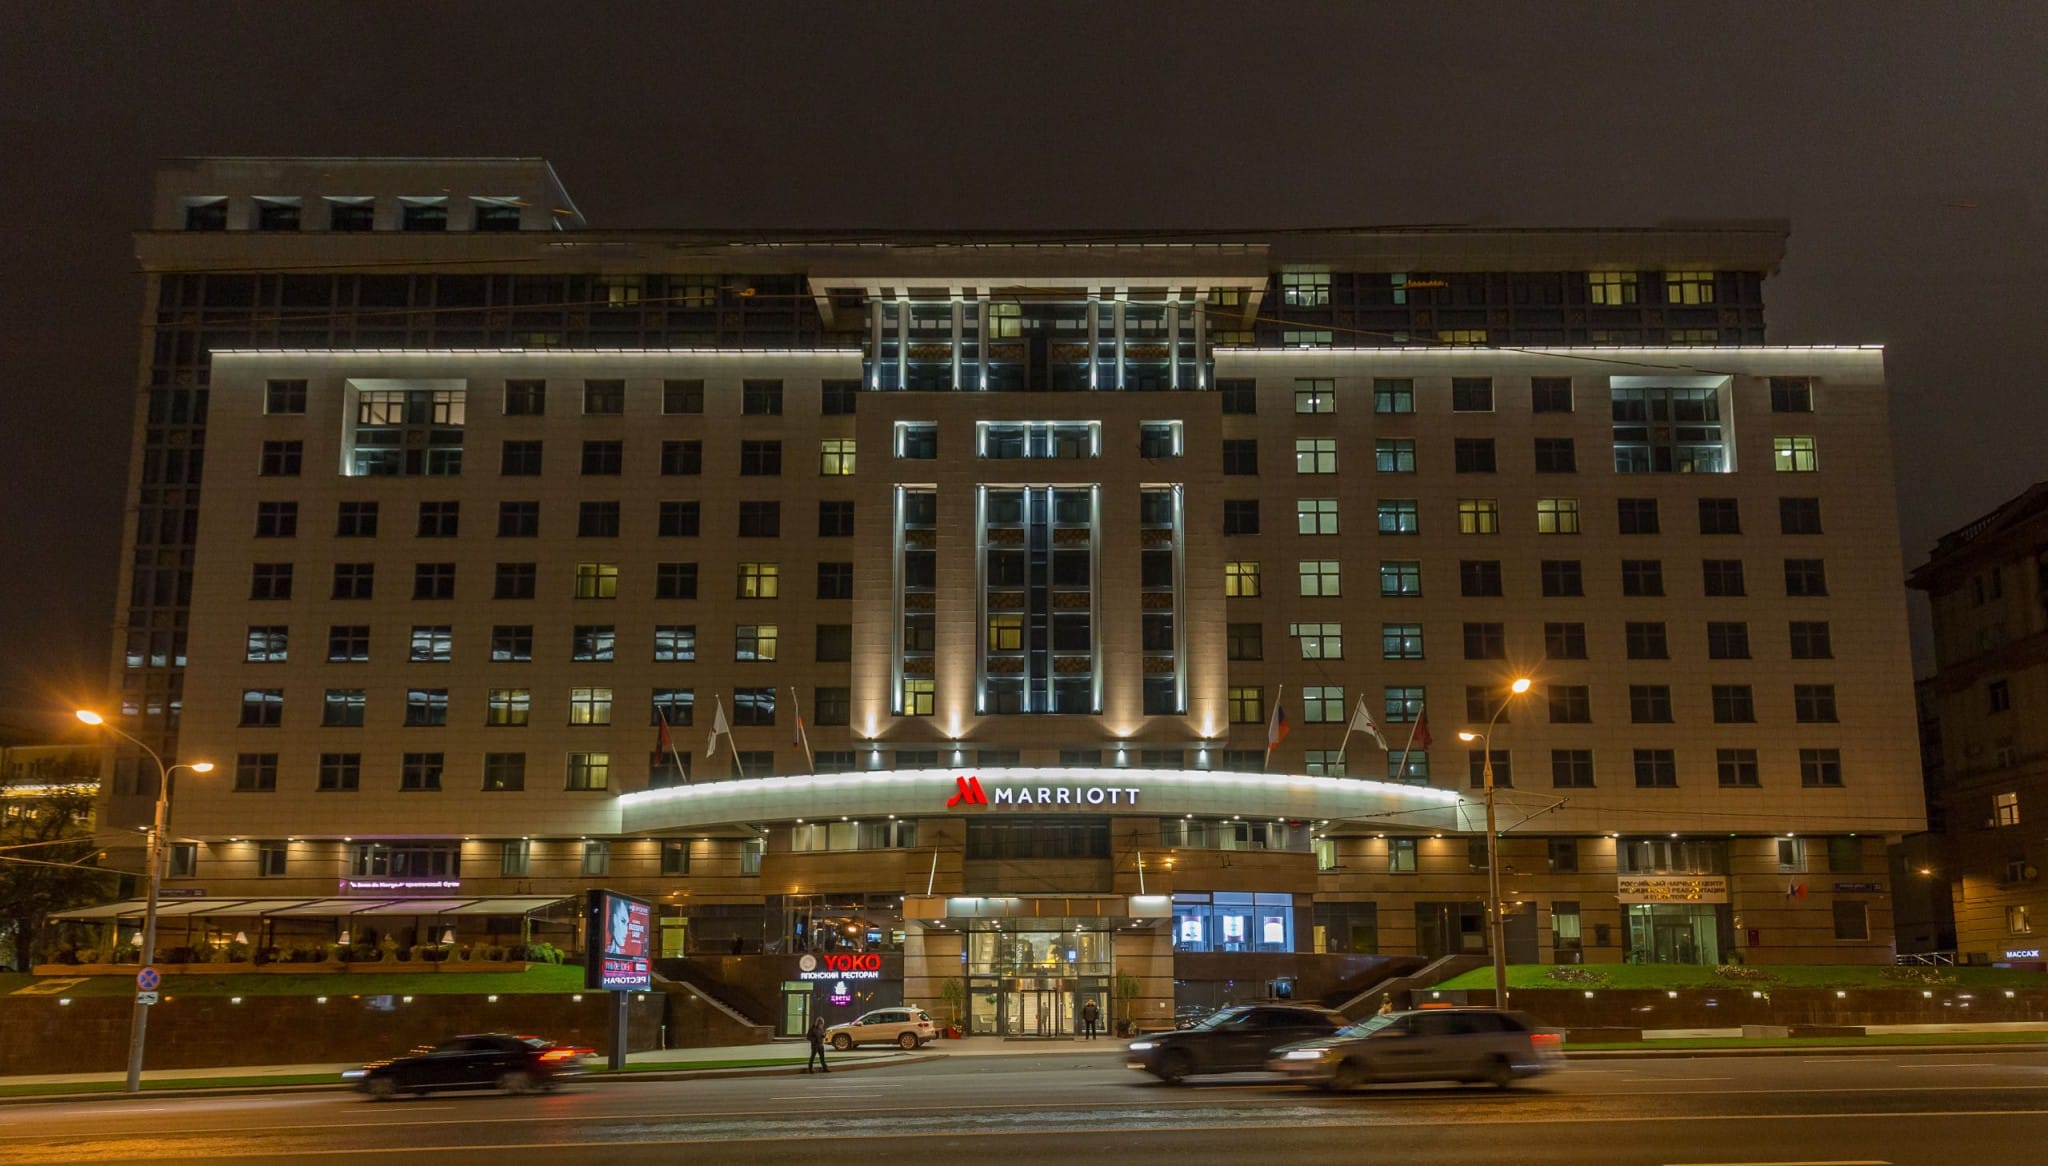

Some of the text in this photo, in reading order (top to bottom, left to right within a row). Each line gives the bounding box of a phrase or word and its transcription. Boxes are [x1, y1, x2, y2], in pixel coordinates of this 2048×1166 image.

[994, 785, 1141, 805] MARRIOTT
[2006, 950, 2040, 959] МАССАЖ
[824, 953, 881, 971] YOKO
[841, 971, 879, 979] РЕСТОРАН
